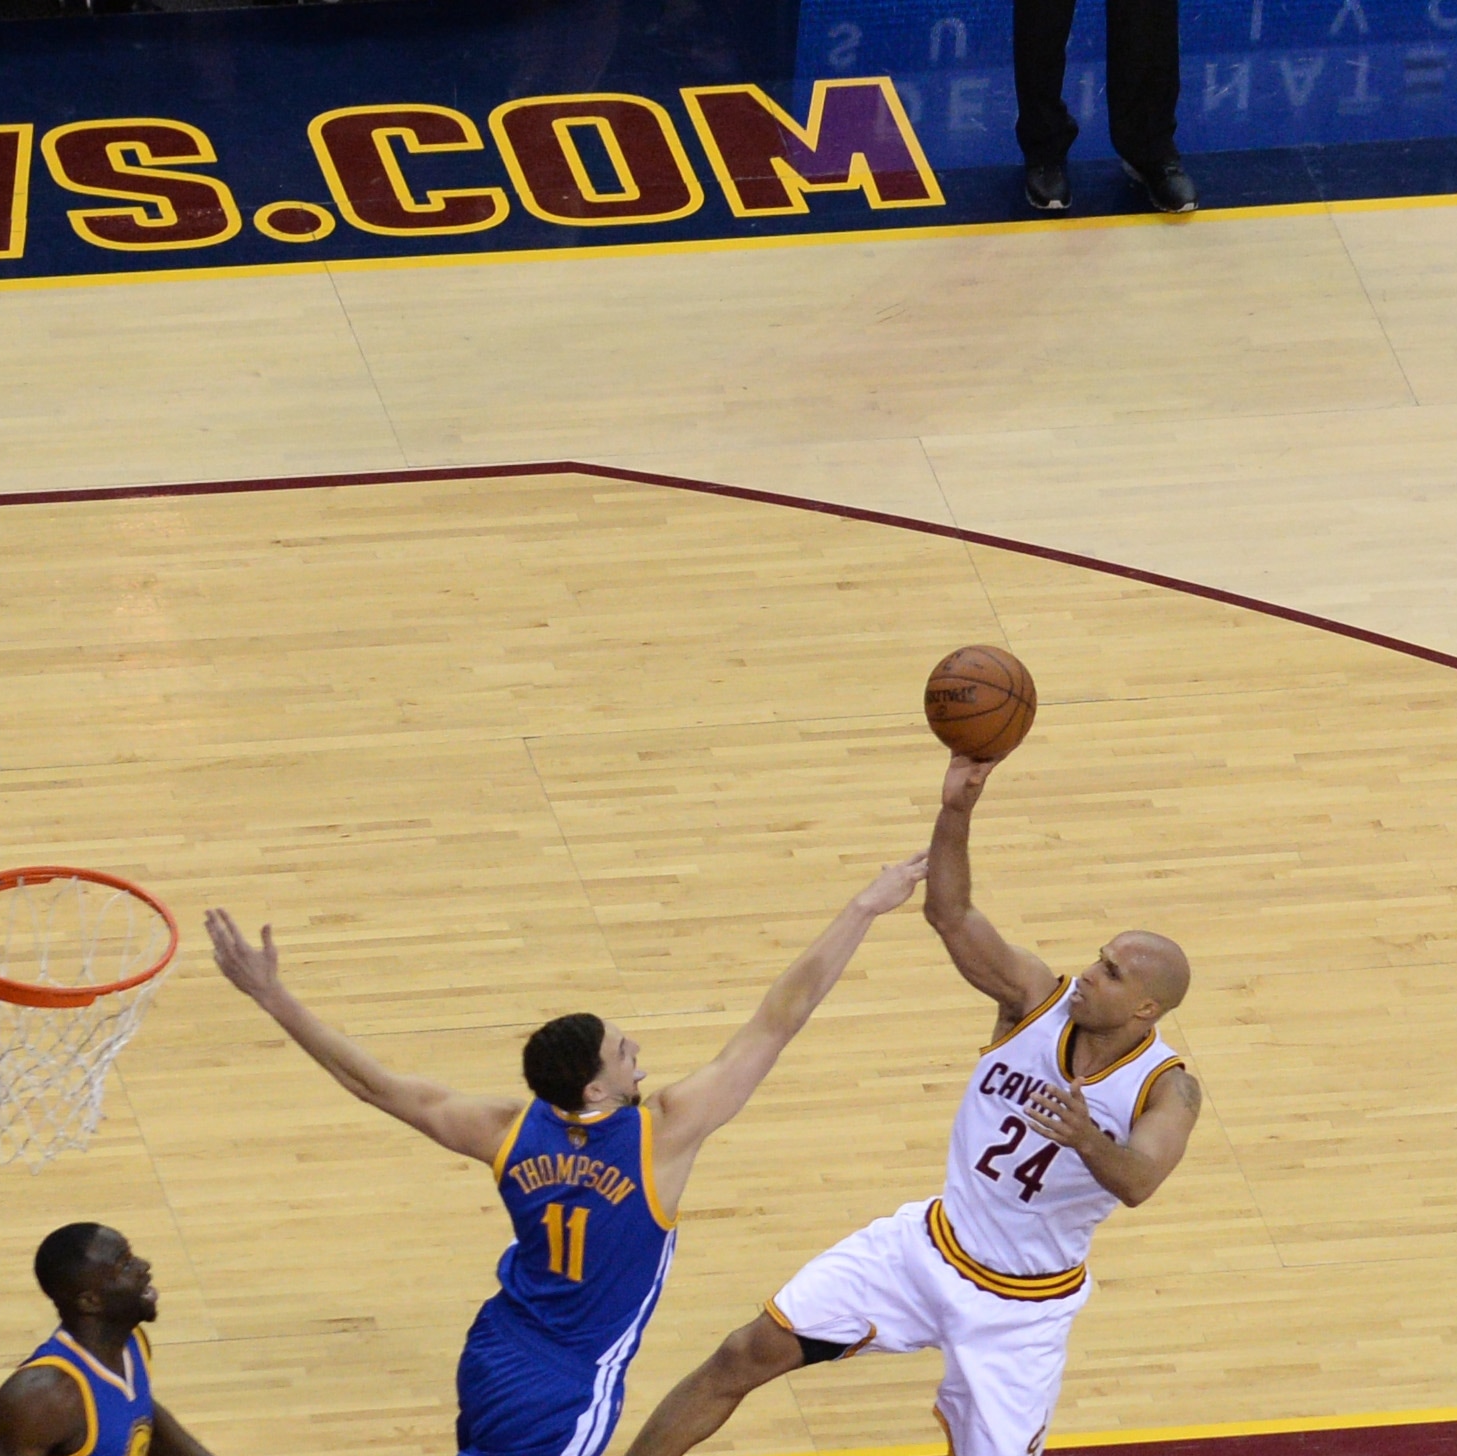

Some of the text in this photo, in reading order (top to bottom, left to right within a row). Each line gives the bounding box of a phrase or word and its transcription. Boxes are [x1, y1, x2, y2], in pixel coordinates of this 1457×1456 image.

[507, 1153, 636, 1206] THOMPSON
[974, 1115, 1061, 1204] 24
[540, 1202, 591, 1283] 11
